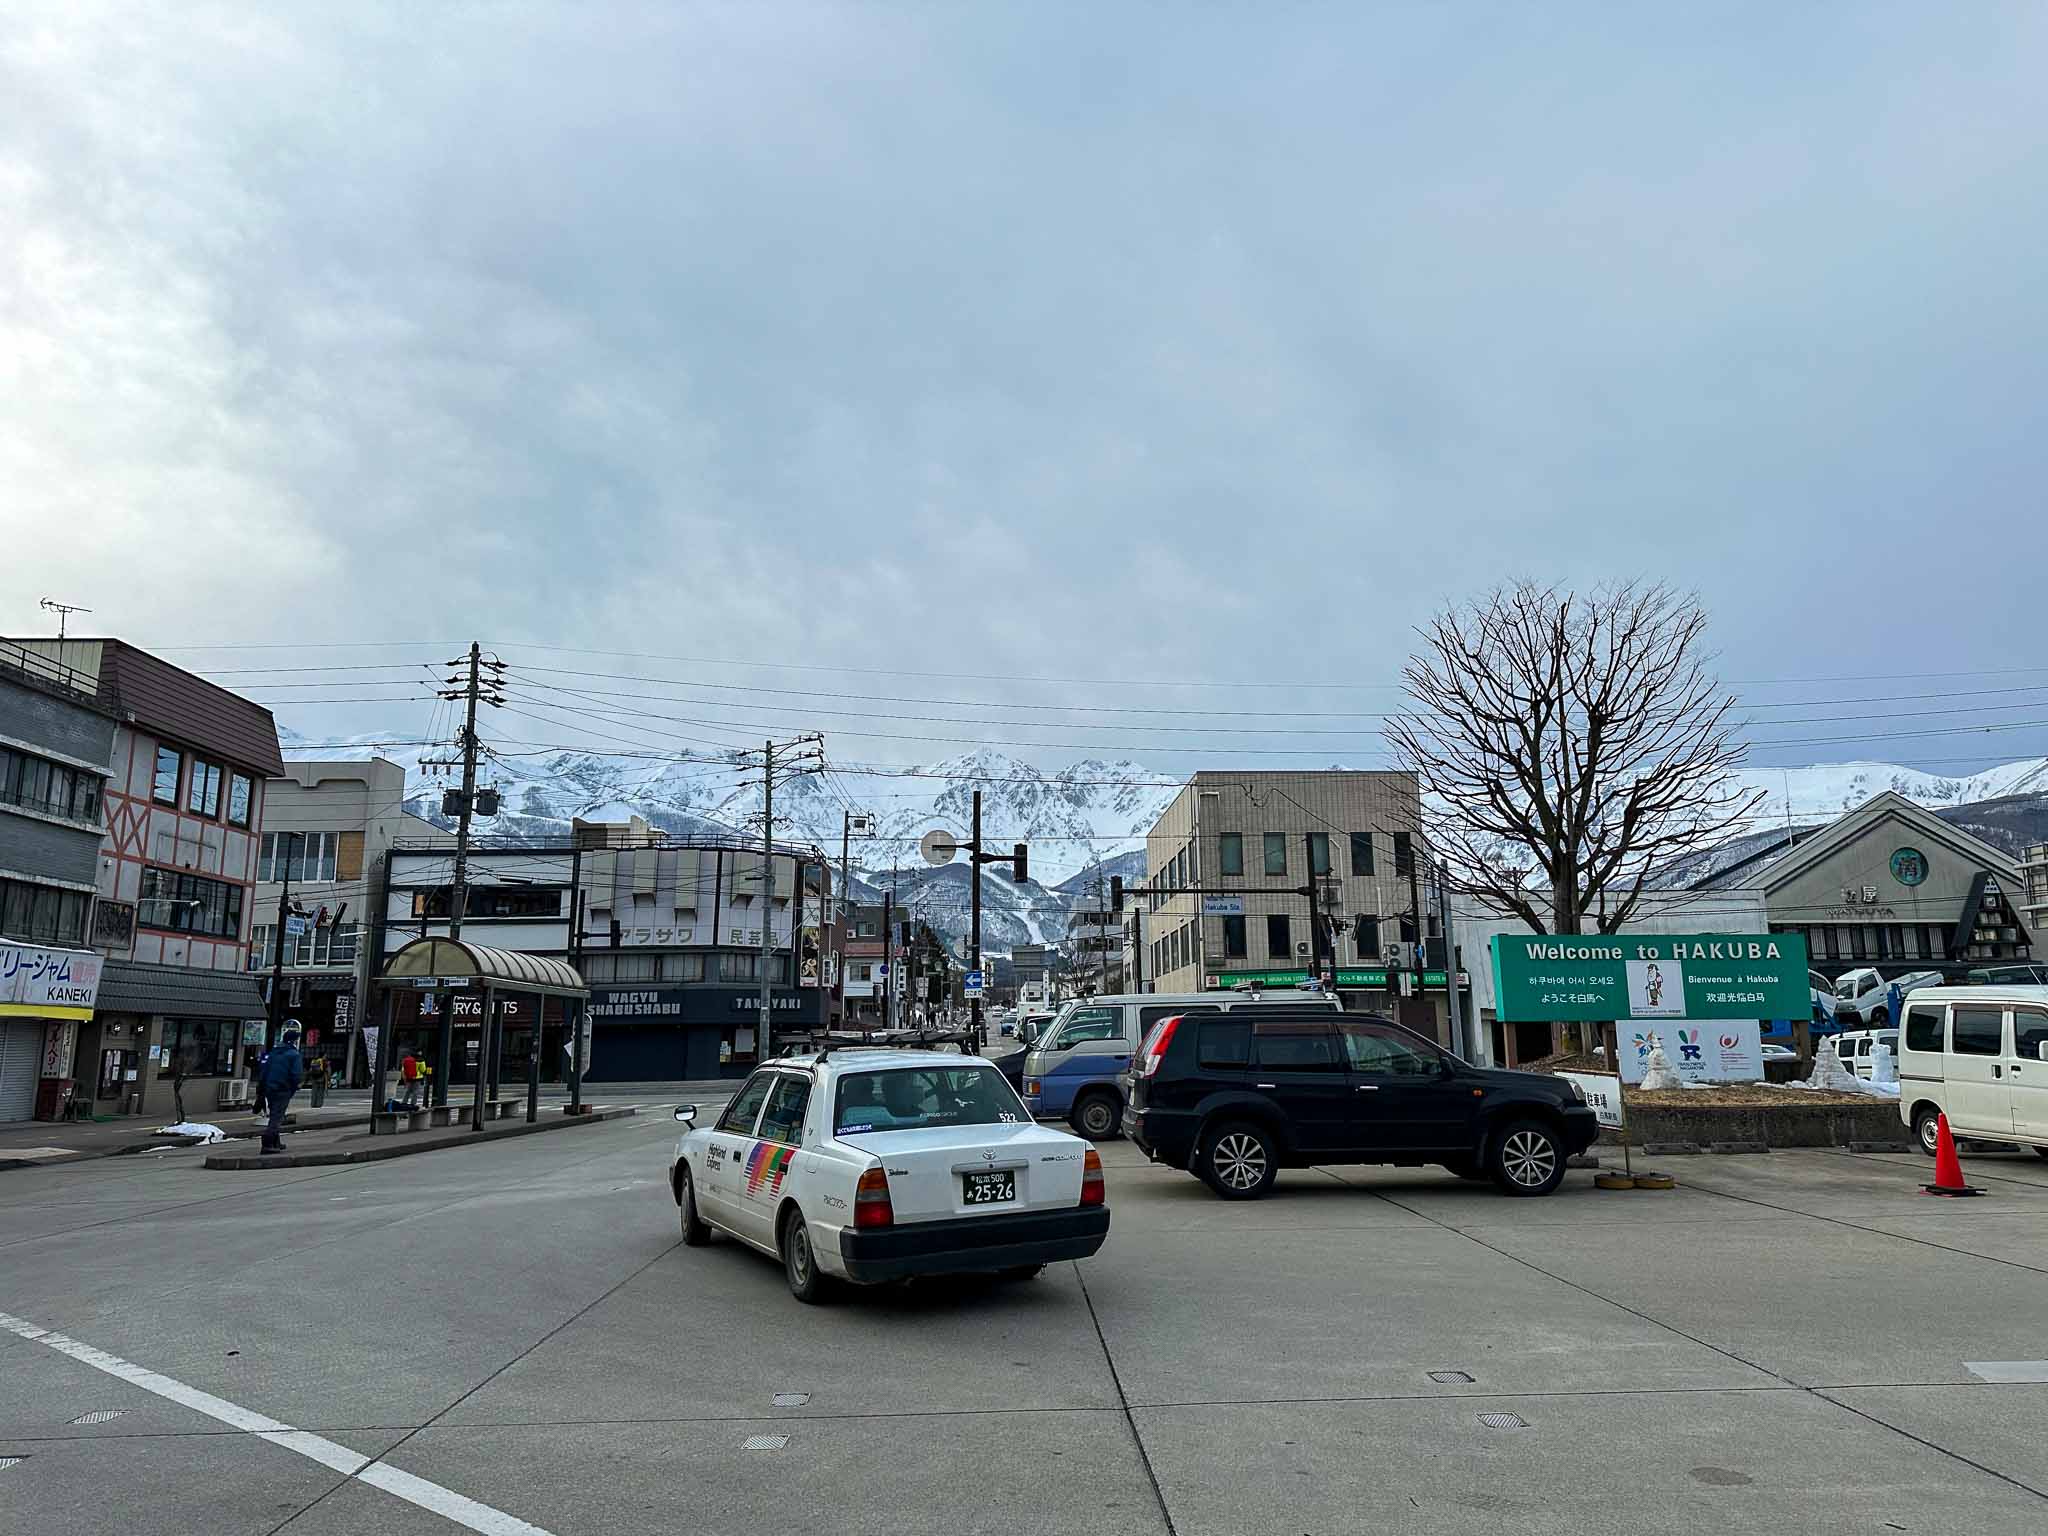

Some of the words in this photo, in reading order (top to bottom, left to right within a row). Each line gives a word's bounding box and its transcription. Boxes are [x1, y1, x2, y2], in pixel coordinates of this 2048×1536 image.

[1526, 943, 1623, 960] Welcome
[1637, 944, 1660, 960] to
[1673, 943, 1782, 960] HAKUBA
[0, 950, 71, 982] リージャム
[1528, 976, 1566, 986] 하쿠바에
[1568, 977, 1586, 985] 어서
[1589, 976, 1615, 986] 오세요
[1688, 975, 1733, 984] Bienvenue
[1746, 975, 1779, 984] Hakuba
[47, 987, 92, 1002] KANEKI
[608, 992, 658, 1003] WAGYU
[1541, 993, 1605, 1004] ようこそ白馬へ
[1706, 992, 1765, 1003] 欢迎光临白马
[472, 1002, 481, 1015] &
[587, 1003, 680, 1015] SHABUSHABU
[736, 998, 800, 1009] TAKYAKI
[1584, 1092, 1608, 1109] 駐車場
[999, 1112, 1017, 1122] 522
[709, 1143, 727, 1160] Highland
[707, 1159, 721, 1171] Express
[991, 1174, 1005, 1183] 500
[975, 1183, 1013, 1202] 25-26
